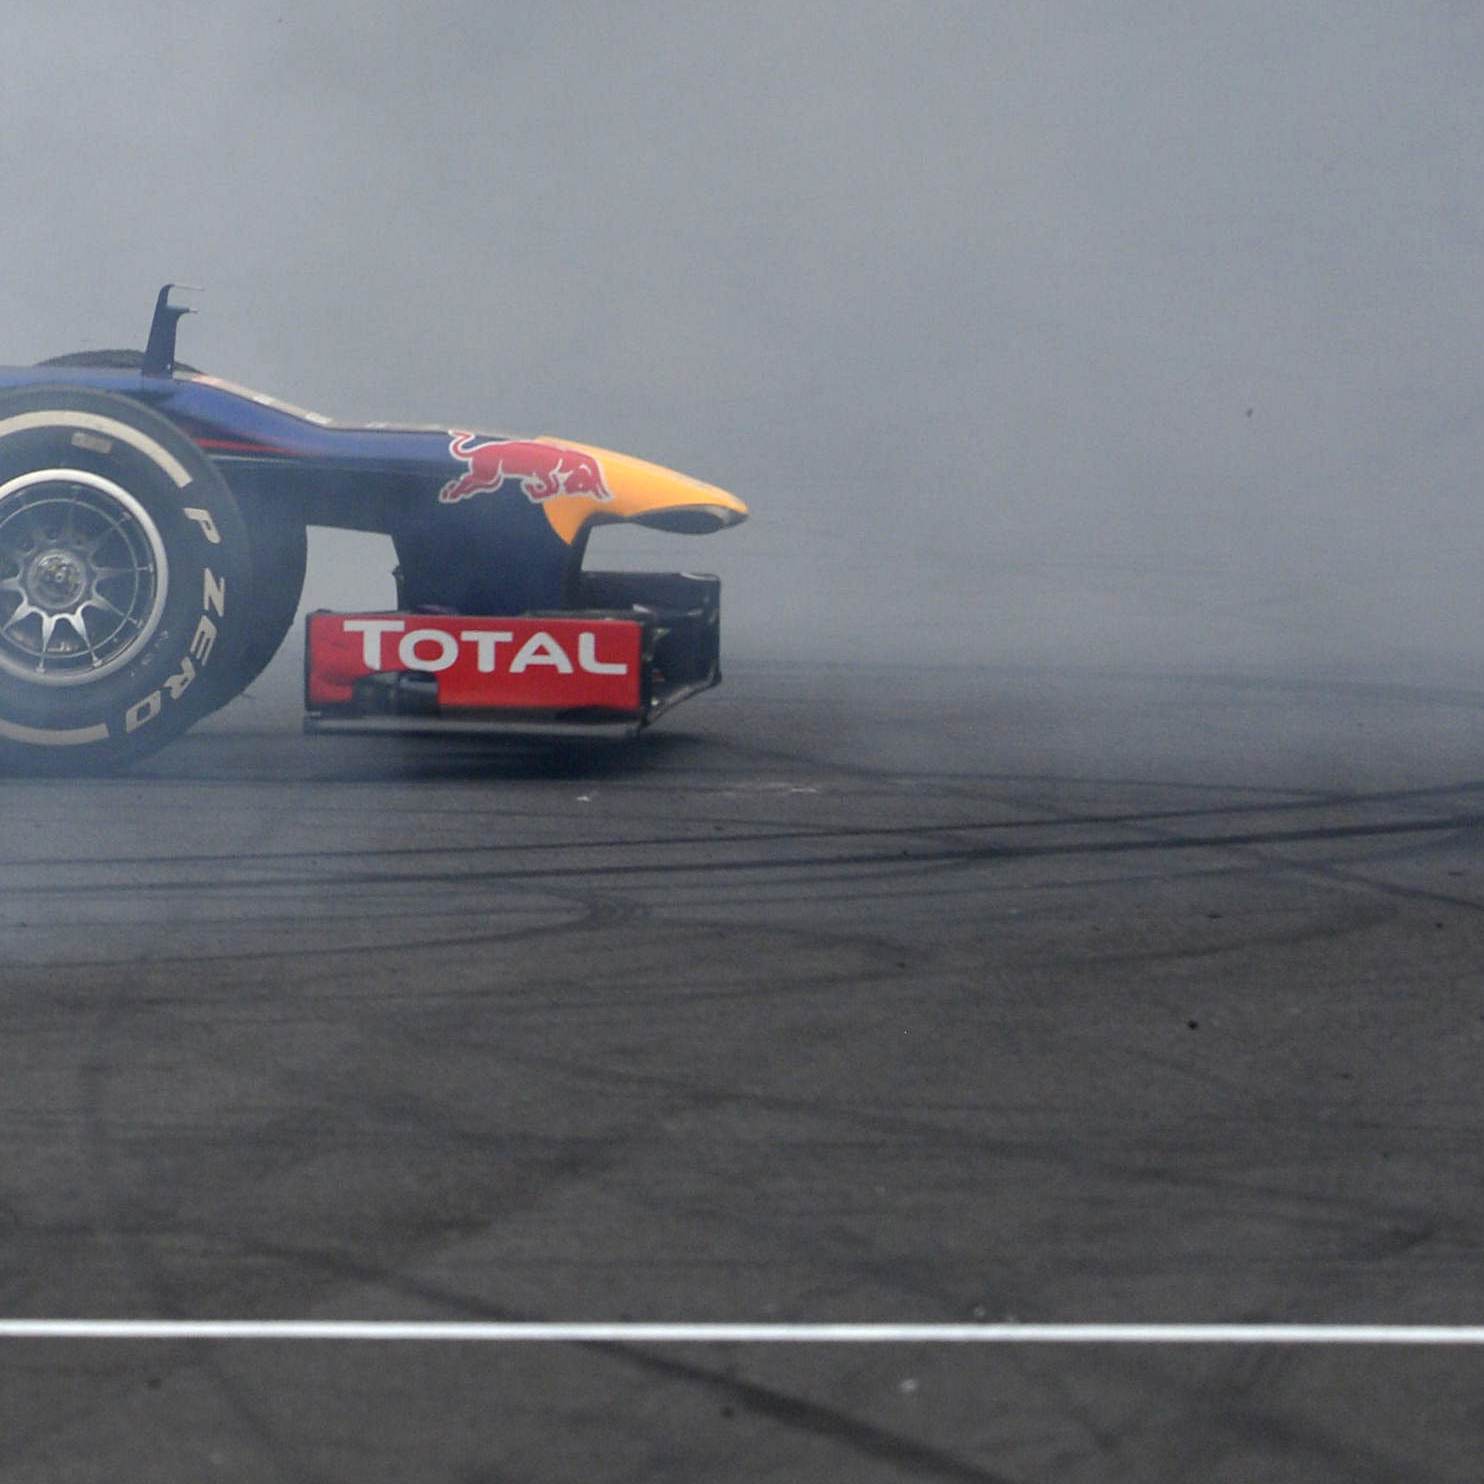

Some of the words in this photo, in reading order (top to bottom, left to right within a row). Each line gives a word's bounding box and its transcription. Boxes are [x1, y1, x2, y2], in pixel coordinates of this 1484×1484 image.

[184, 507, 221, 544] P
[126, 568, 225, 733] ZERO
[343, 619, 628, 675] TOTAL
